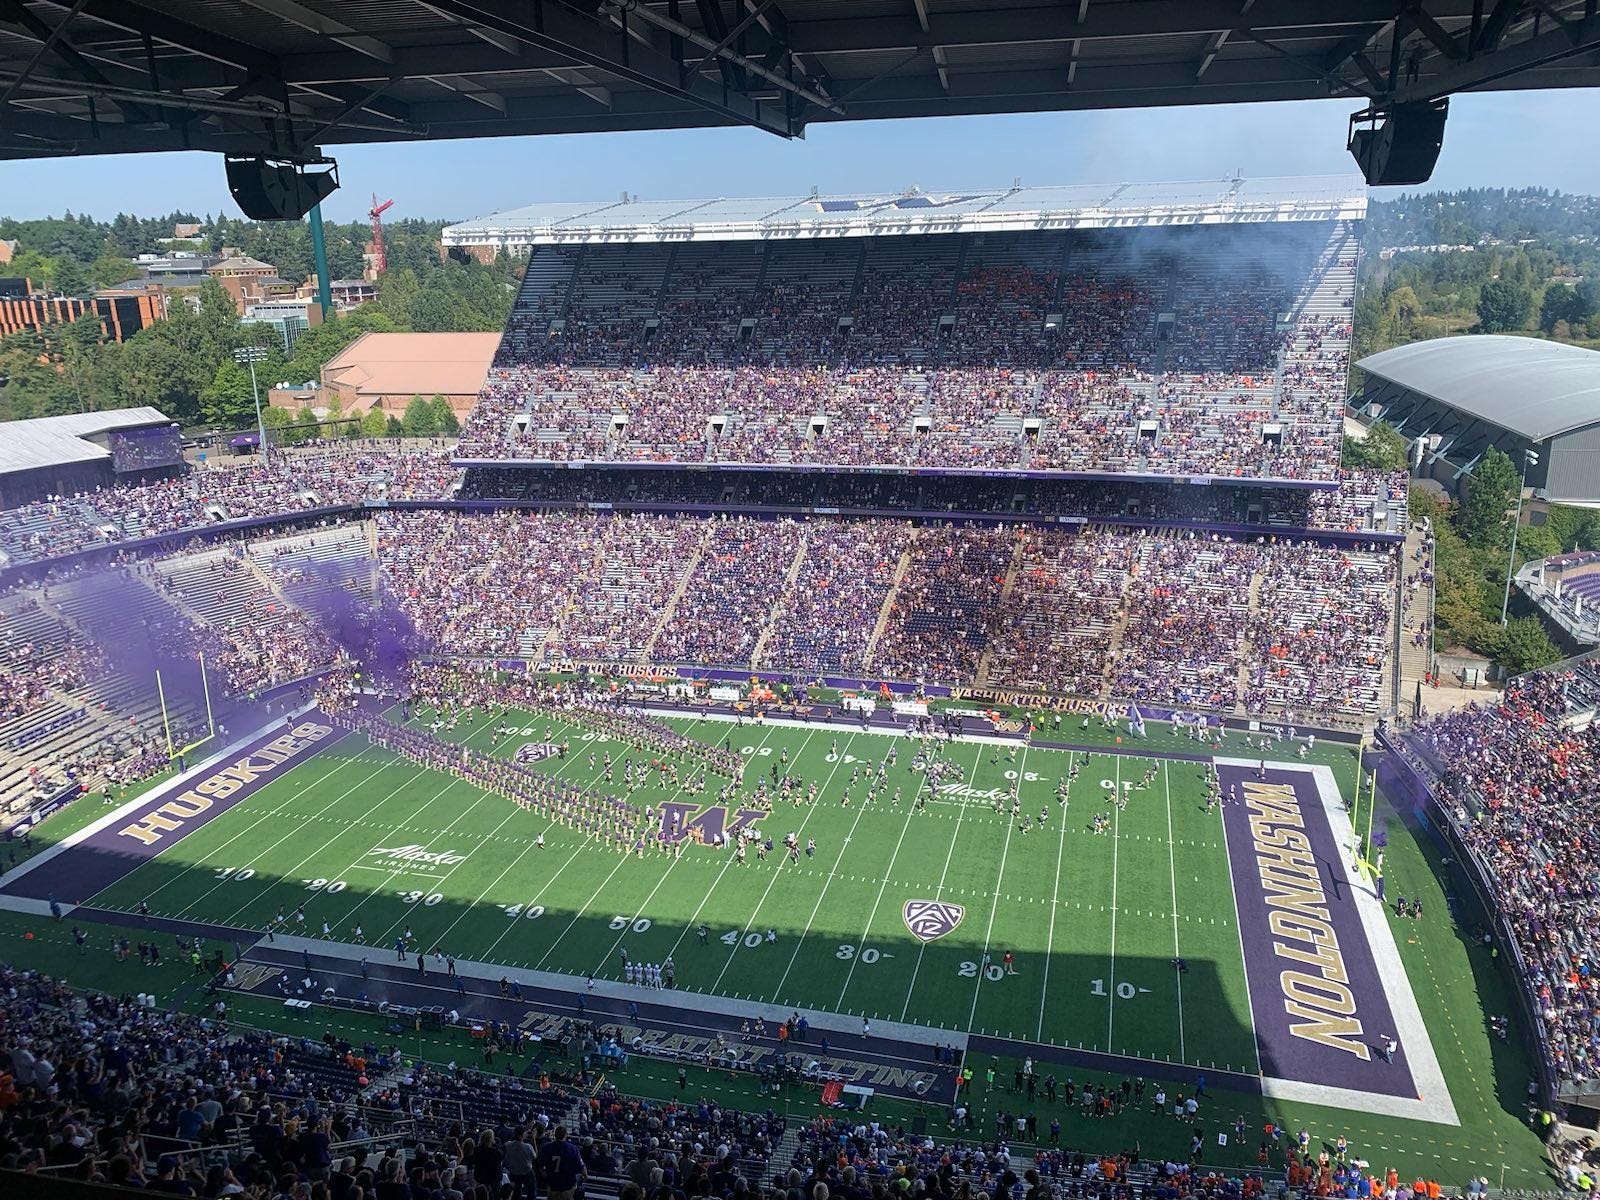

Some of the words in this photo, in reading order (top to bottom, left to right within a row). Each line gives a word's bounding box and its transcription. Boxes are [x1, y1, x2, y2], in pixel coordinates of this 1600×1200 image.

[619, 664, 678, 677] HUSKIES
[117, 721, 334, 845] HUSKIES
[368, 844, 466, 865] Alaska
[214, 866, 255, 880] 10
[374, 859, 436, 871] AIRLINES
[304, 878, 347, 893] 20
[402, 890, 443, 906] 30
[504, 903, 545, 919] 40
[608, 915, 651, 933] 50
[1241, 781, 1372, 1061] WASHINGTON
[720, 930, 762, 948] 40
[835, 944, 880, 964] 30
[957, 961, 1004, 981] 20
[1090, 979, 1136, 999] 10
[517, 1011, 594, 1041] TH
